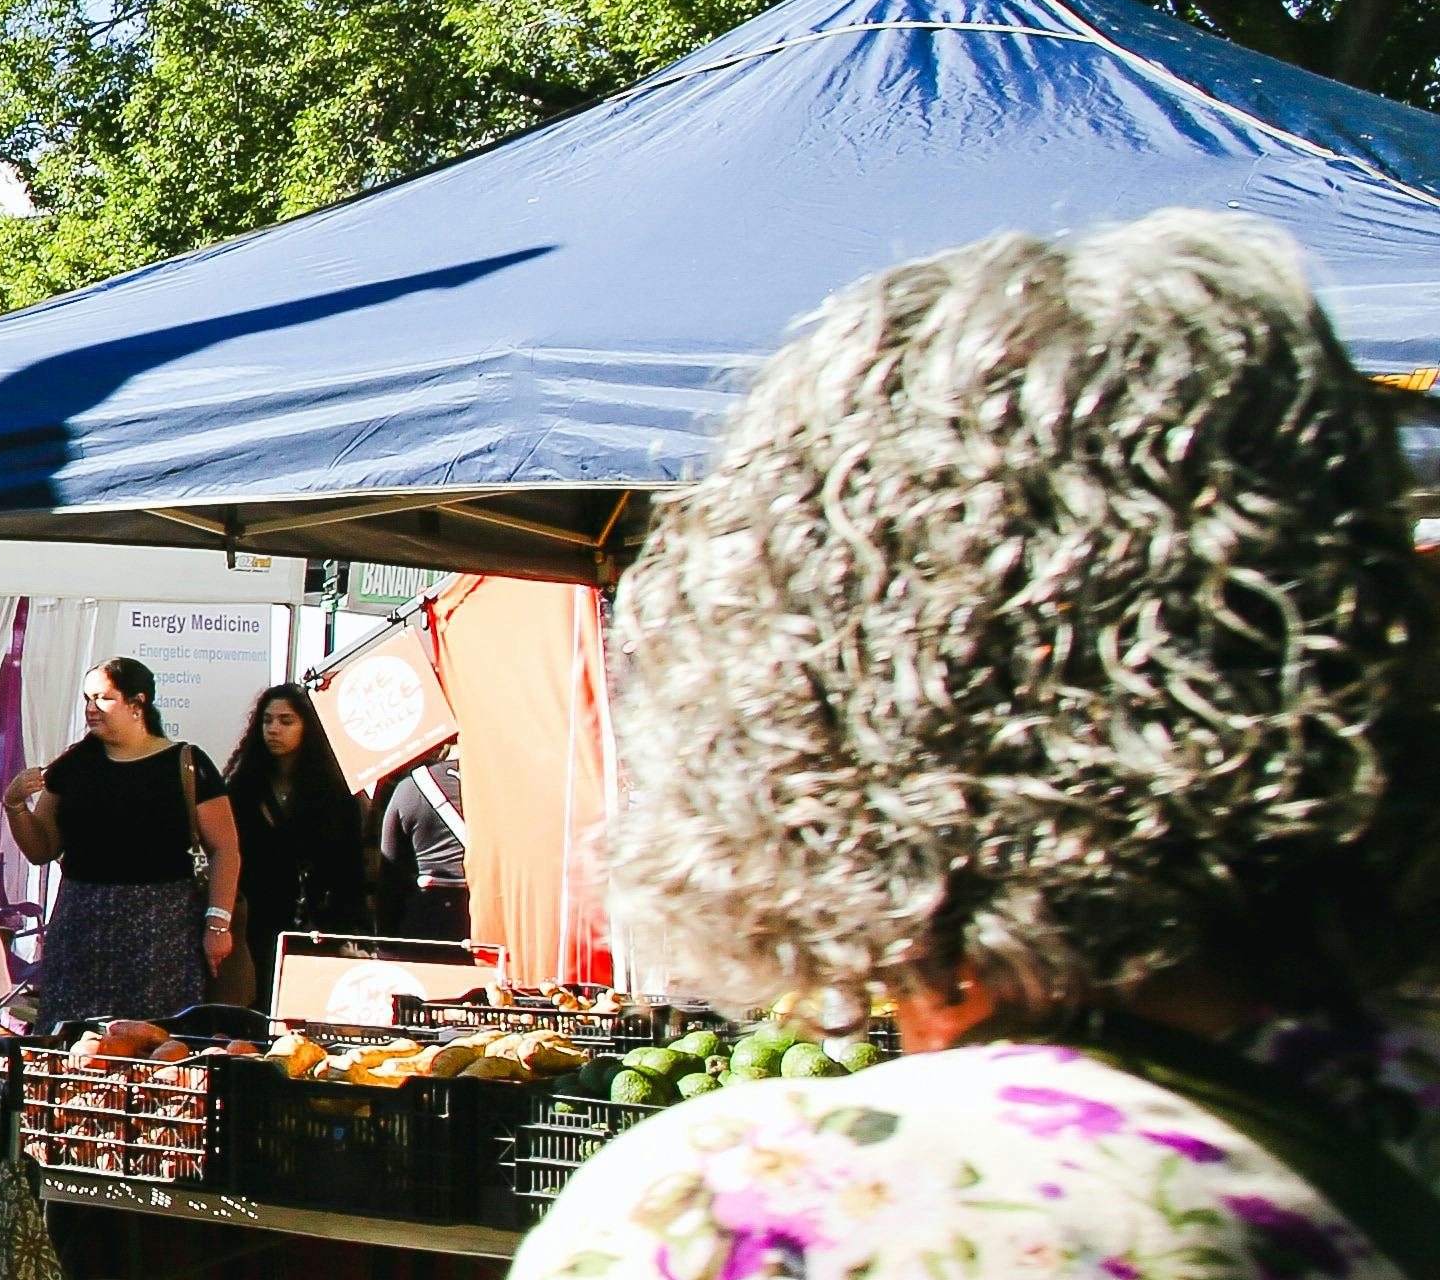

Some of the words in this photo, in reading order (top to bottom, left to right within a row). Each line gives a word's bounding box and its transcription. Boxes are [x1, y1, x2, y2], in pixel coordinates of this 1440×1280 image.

[362, 563, 428, 597] BANANA
[132, 611, 186, 634] Energy
[191, 614, 260, 633] Medicine
[139, 643, 191, 661] Energetic
[193, 647, 267, 662] empowerment
[155, 671, 201, 684] spective
[157, 695, 191, 709] dance
